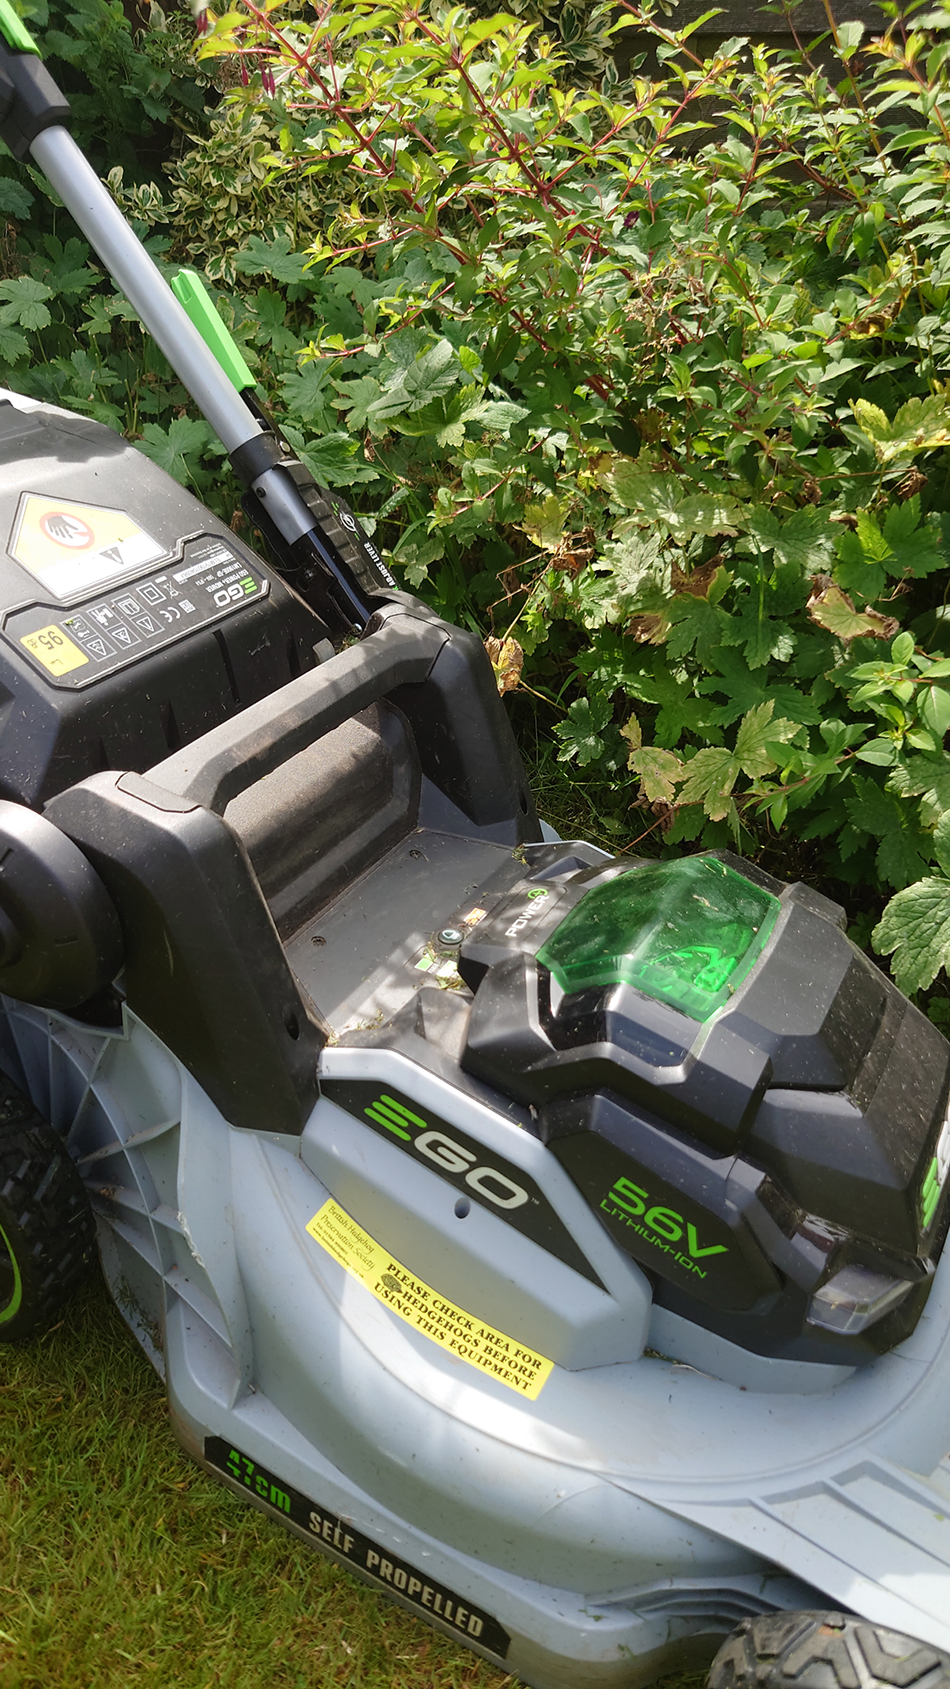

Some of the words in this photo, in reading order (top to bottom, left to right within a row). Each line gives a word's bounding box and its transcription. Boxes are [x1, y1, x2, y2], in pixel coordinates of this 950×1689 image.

[364, 542, 381, 563] LEVER
[376, 561, 396, 586] ADJUST
[213, 576, 258, 607] EGO
[38, 631, 64, 650] 95
[504, 895, 550, 937] POWER
[364, 1094, 529, 1210] EGO
[321, 1214, 354, 1249] Preservation
[353, 1247, 375, 1271] Society
[328, 1205, 348, 1228] British
[347, 1225, 375, 1255] Hedgehog
[600, 1198, 708, 1279] LITHIUM-ION
[607, 1175, 729, 1259] 56V
[374, 1282, 413, 1317] USING
[416, 1314, 447, 1341] THIS
[449, 1338, 532, 1391] EQUIPMENT
[386, 1263, 431, 1301] PLEASE
[432, 1300, 475, 1331] CHECK
[476, 1328, 510, 1352] AREA
[514, 1348, 543, 1370] FOR
[402, 1291, 481, 1347] HEDGEHOGS
[483, 1344, 537, 1381] BEFORE
[226, 1450, 291, 1513] 47cm
[308, 1510, 355, 1554] SELF
[366, 1549, 483, 1638] PROPELLED
